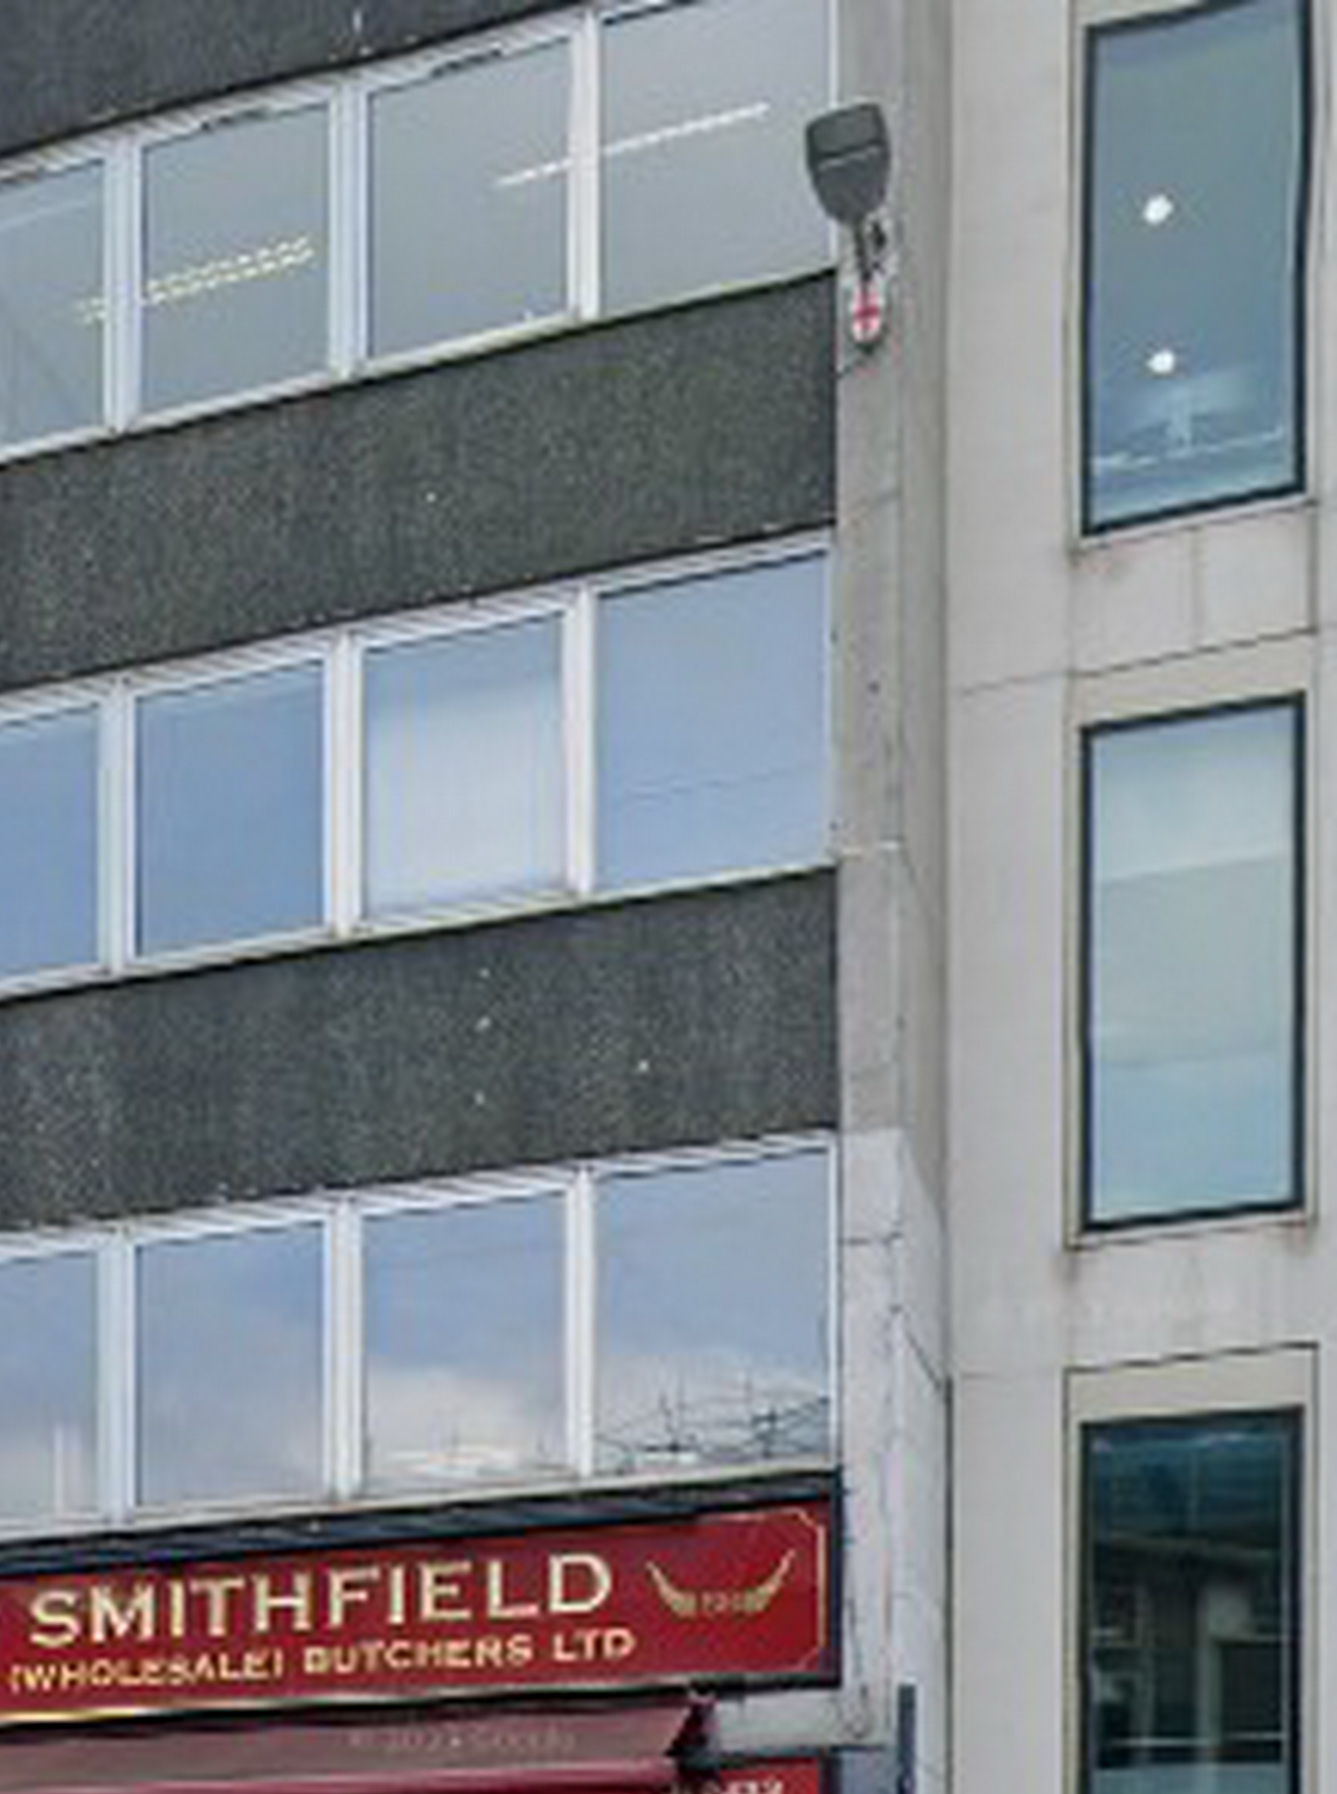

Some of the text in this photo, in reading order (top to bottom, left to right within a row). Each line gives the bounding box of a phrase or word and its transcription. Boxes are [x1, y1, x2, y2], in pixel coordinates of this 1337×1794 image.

[28, 1552, 614, 1648] SMITHFIELD
[9, 1627, 637, 1694] (WHOLESALE) BUTCHERS LTD
